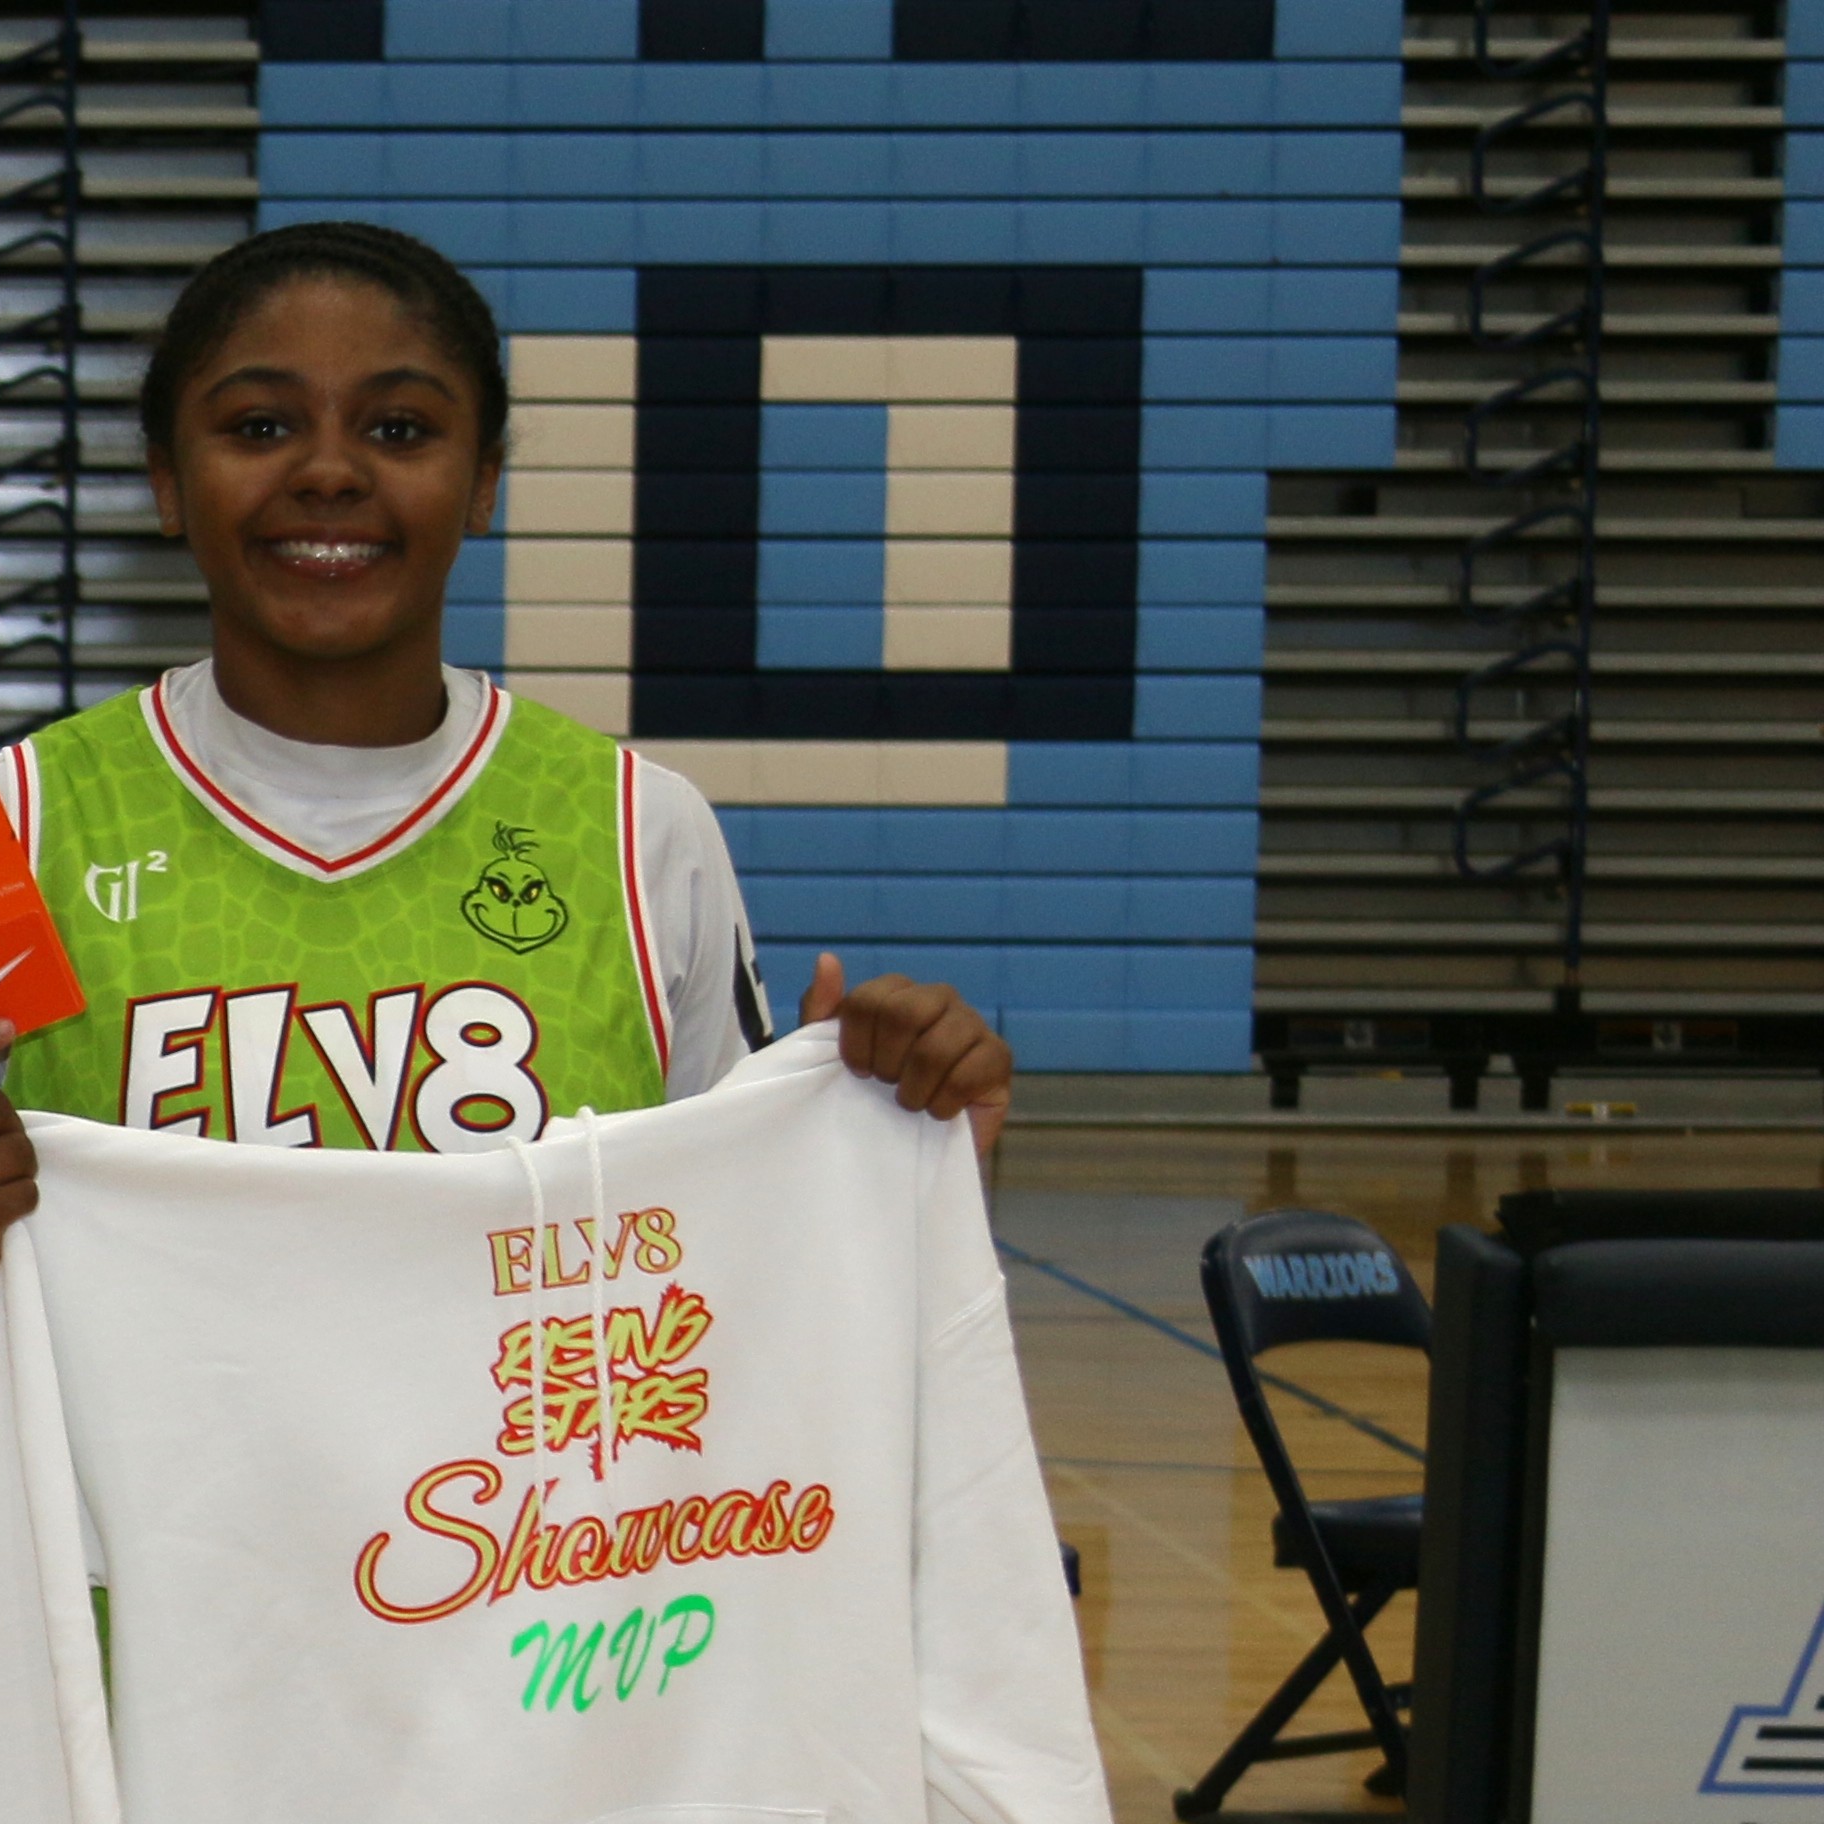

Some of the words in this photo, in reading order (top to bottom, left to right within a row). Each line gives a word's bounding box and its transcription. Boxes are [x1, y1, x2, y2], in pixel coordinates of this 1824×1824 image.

[118, 978, 550, 1154] ELV8
[486, 1206, 683, 1297] ELV8
[1241, 1252, 1399, 1298] WARRIORS
[488, 1280, 713, 1393] RISING
[496, 1367, 708, 1481] STARS
[354, 1458, 835, 1625] Showcase
[510, 1593, 716, 1713] MVP
